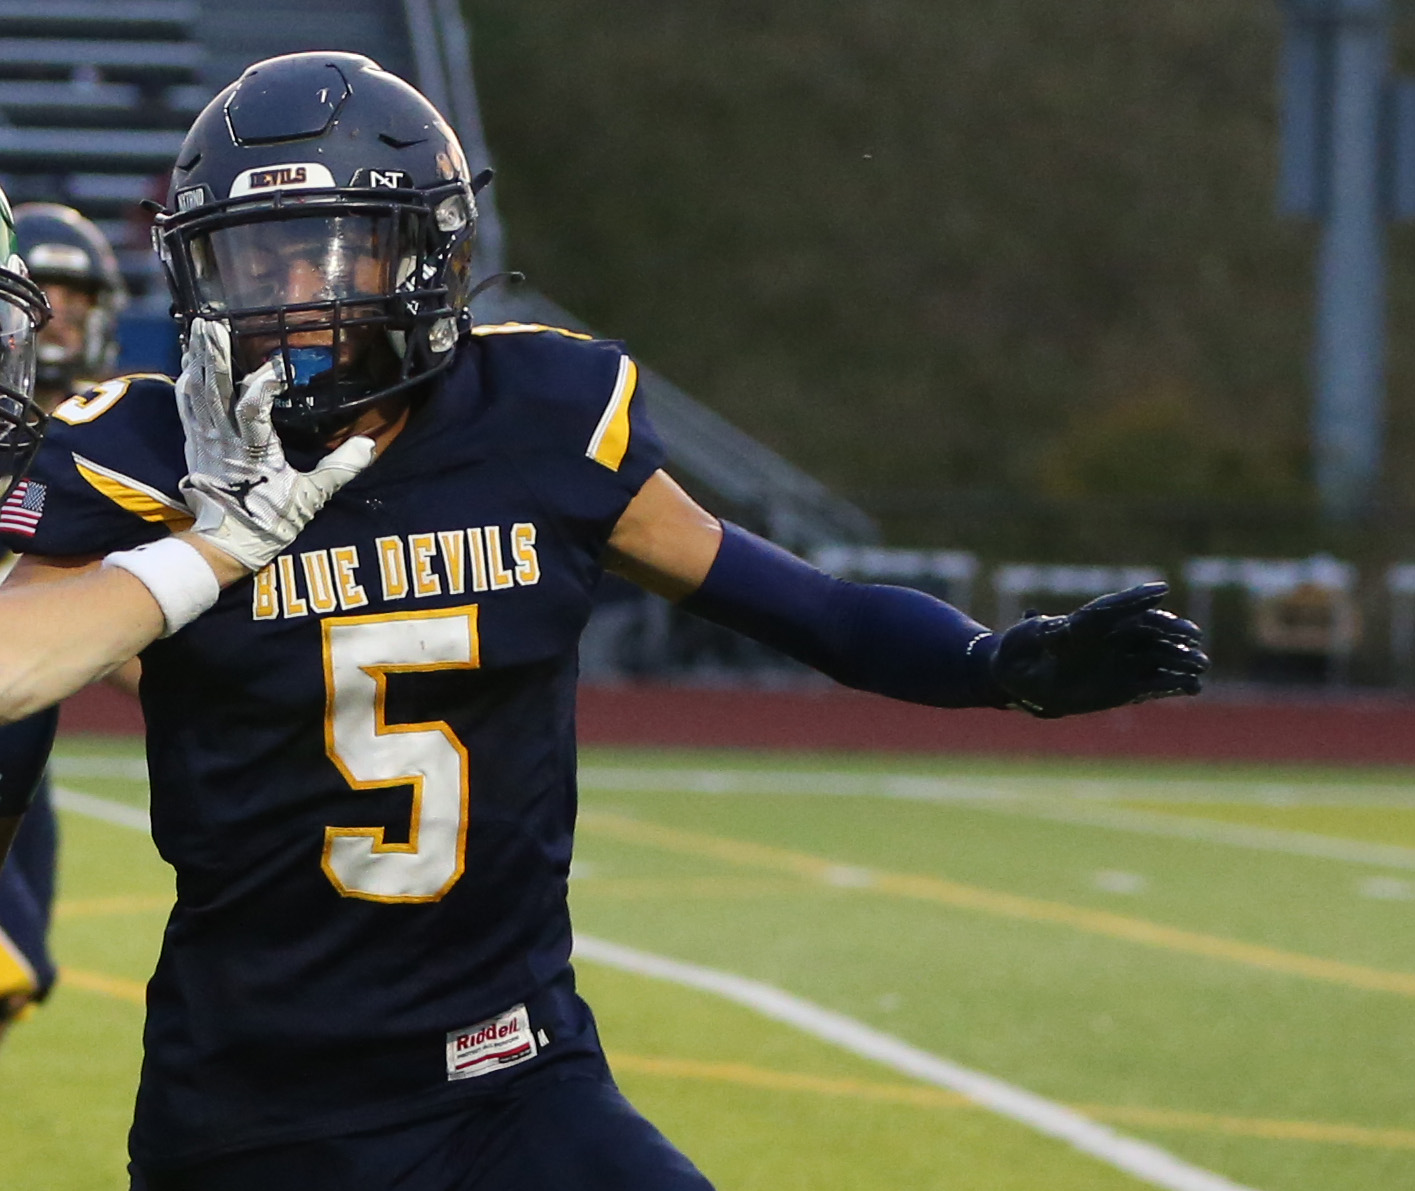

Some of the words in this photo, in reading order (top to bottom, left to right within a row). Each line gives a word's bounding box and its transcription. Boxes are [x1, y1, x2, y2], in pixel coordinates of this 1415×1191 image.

[249, 167, 307, 188] DEVILS
[251, 544, 369, 620] BLUE
[375, 523, 541, 600] DEVILS
[320, 603, 481, 904] 5
